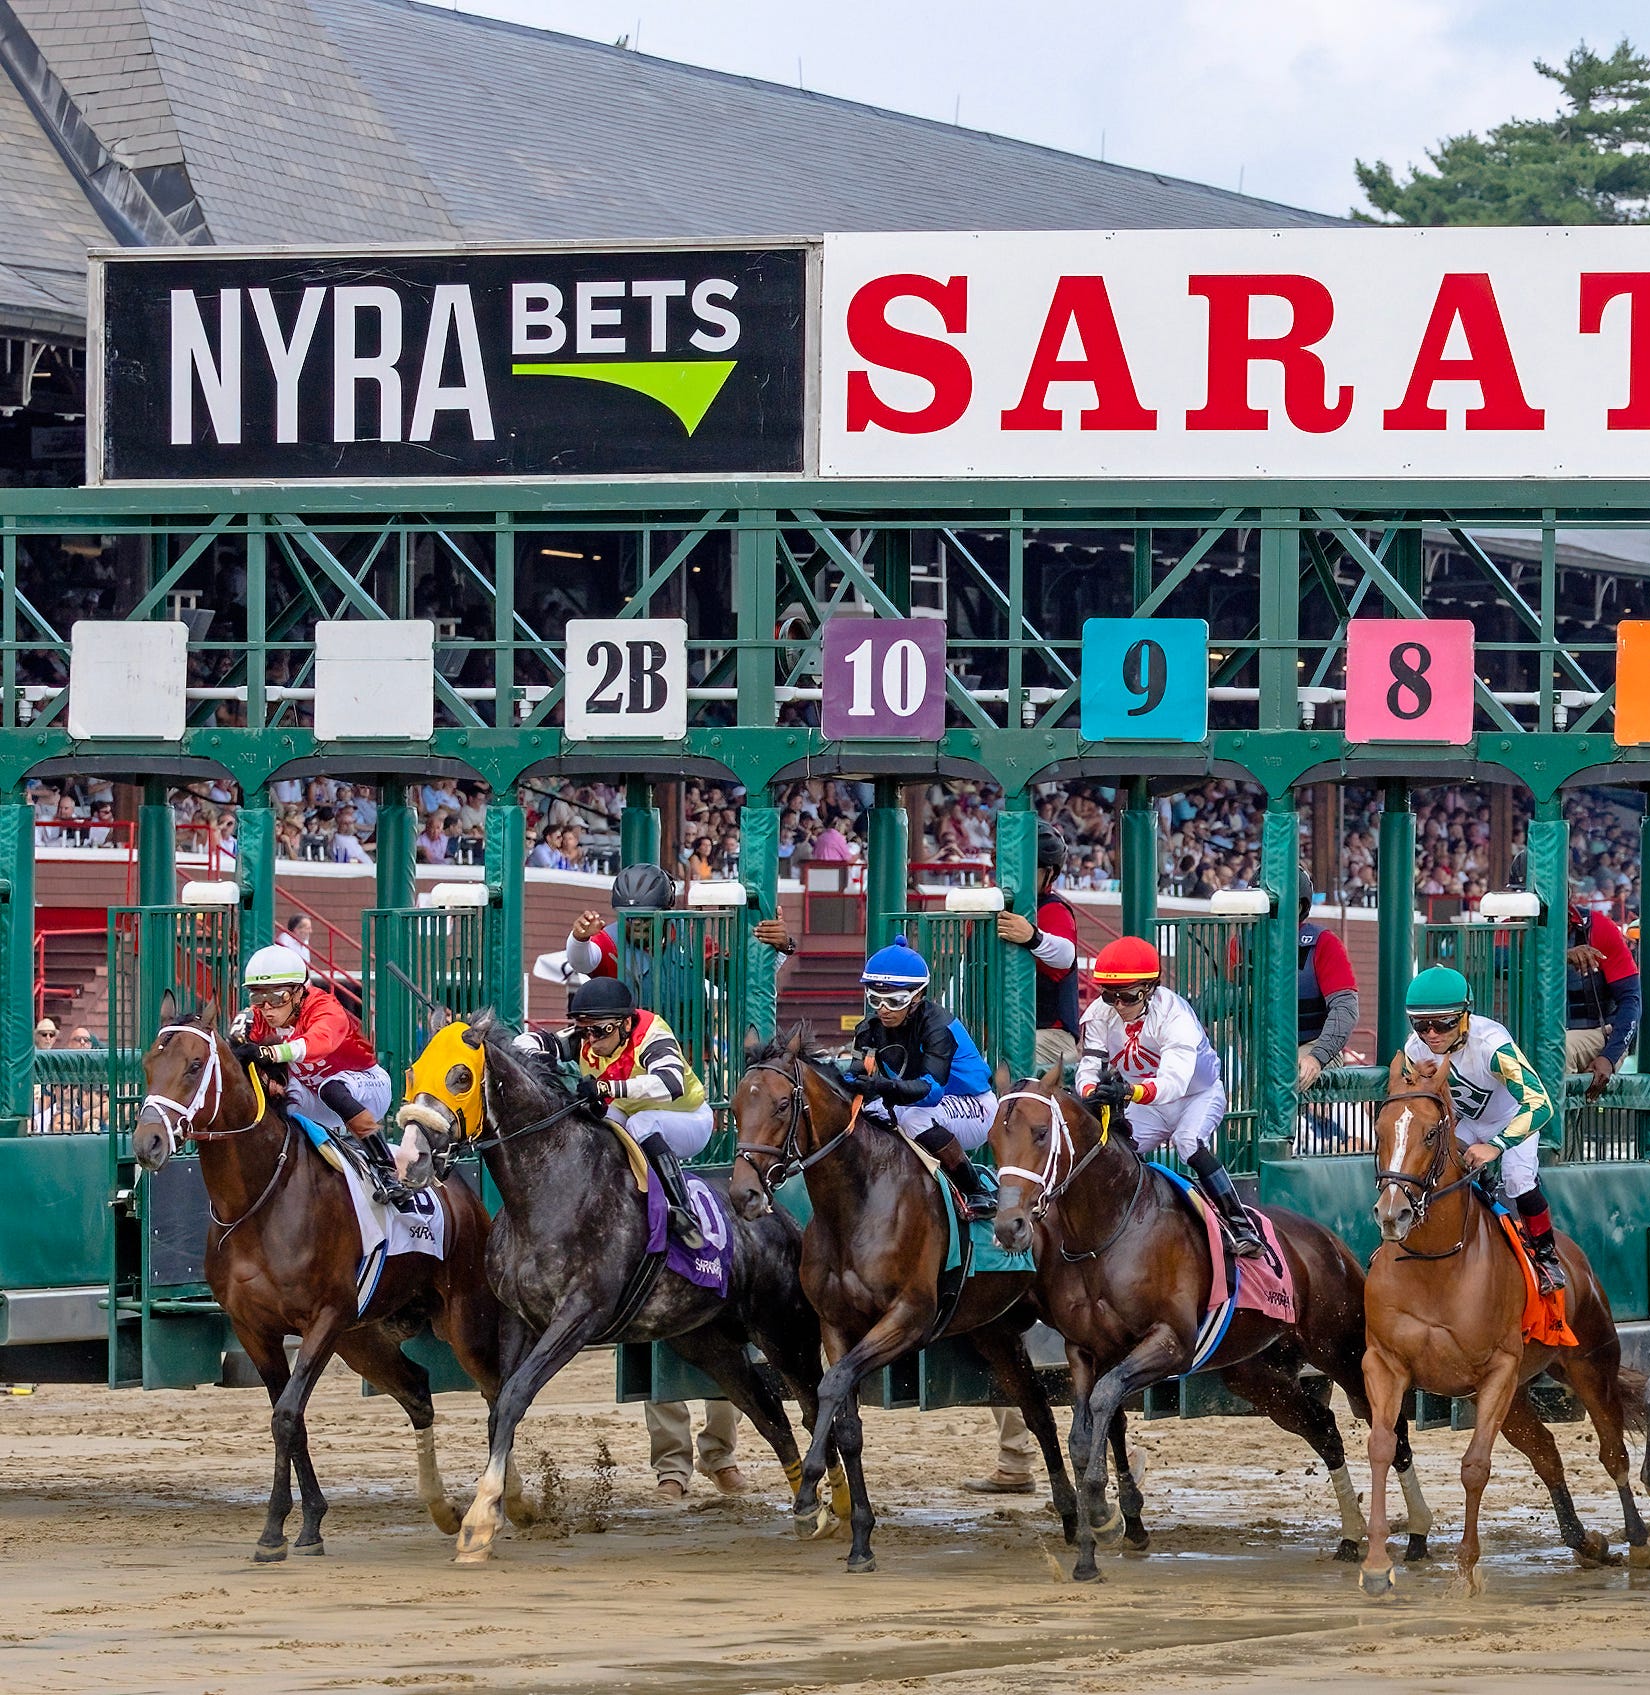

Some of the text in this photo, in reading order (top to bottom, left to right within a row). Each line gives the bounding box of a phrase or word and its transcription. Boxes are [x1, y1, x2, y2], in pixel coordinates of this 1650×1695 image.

[171, 279, 741, 445] NYRA BETS
[586, 641, 668, 714] 2B
[844, 639, 927, 717] 10
[1122, 638, 1168, 717] 9
[1386, 641, 1432, 720] 8
[687, 1179, 727, 1252] 0
